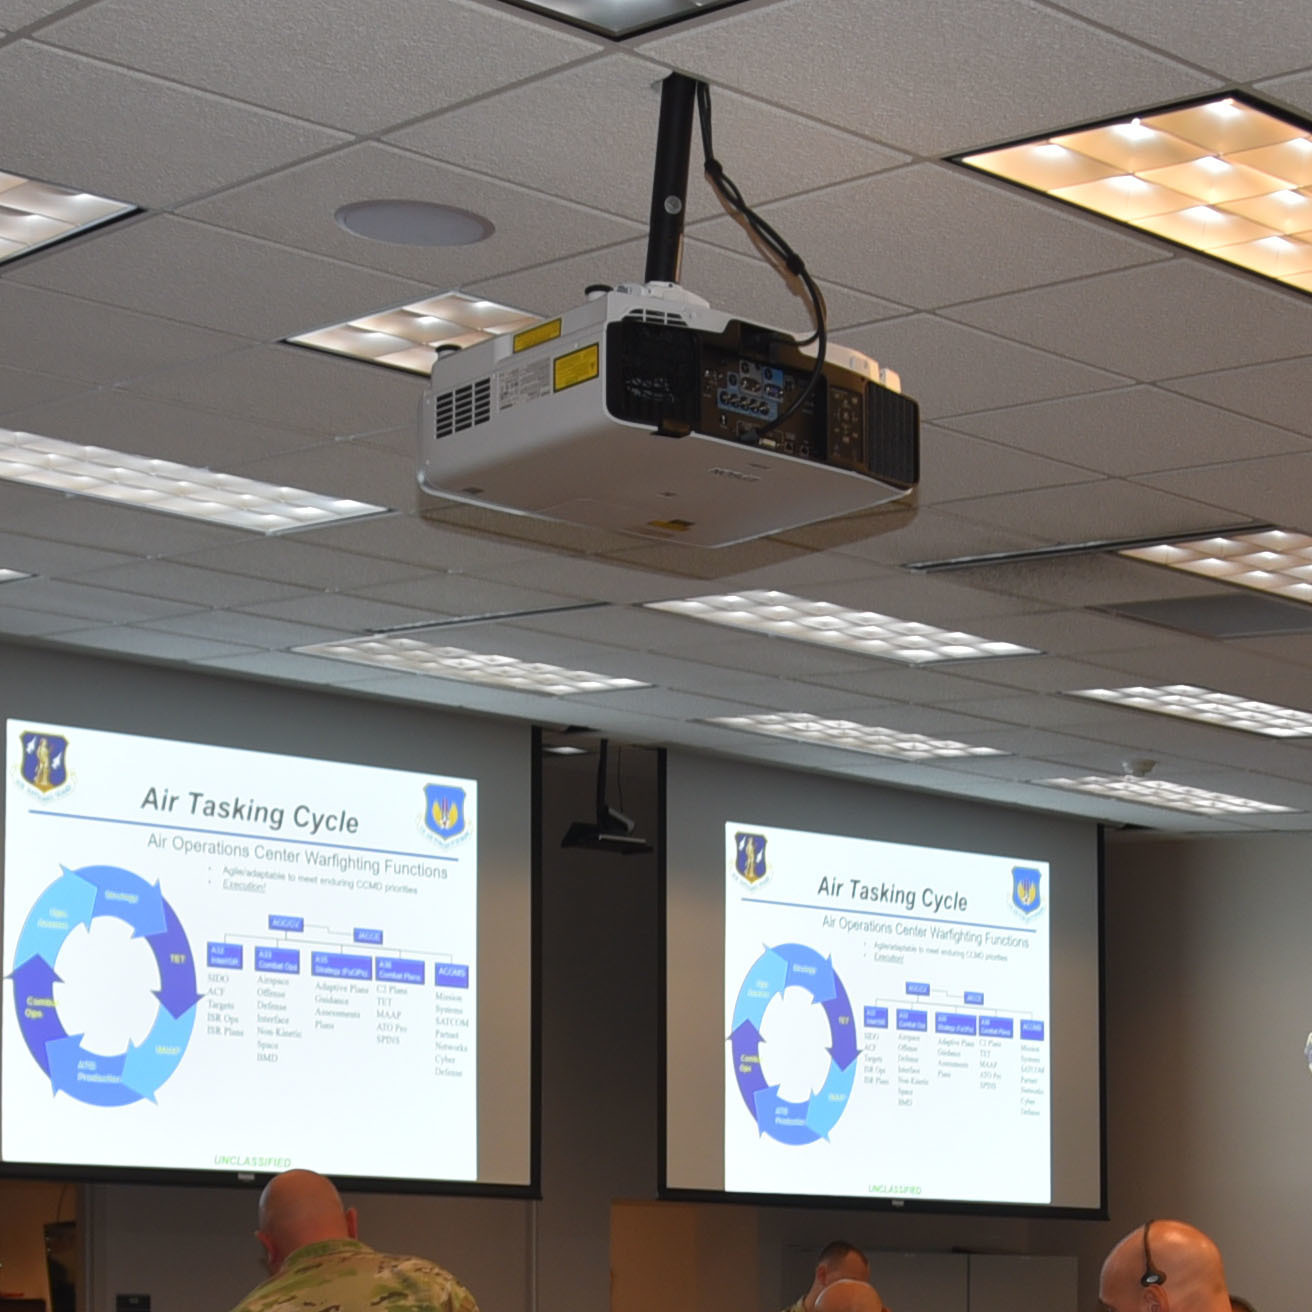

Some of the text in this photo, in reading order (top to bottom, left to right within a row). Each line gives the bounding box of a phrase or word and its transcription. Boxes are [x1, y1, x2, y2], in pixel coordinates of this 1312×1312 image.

[140, 785, 359, 840] Air Tasking Cycle
[148, 832, 447, 879] Air Operations Center Warfighting Functions
[288, 873, 295, 881] to
[817, 875, 967, 916] Air Tasking Cycle
[839, 916, 891, 937] Operations
[895, 922, 926, 938] Center
[929, 925, 981, 946] Warfighting
[985, 931, 1028, 948] Functions
[349, 984, 368, 994] Plans
[208, 999, 234, 1011] Targets
[224, 1014, 238, 1024] Ops
[315, 1020, 334, 1030] Plans
[224, 1027, 243, 1037] Plans
[214, 1154, 293, 1170] UNCLASSIFIED
